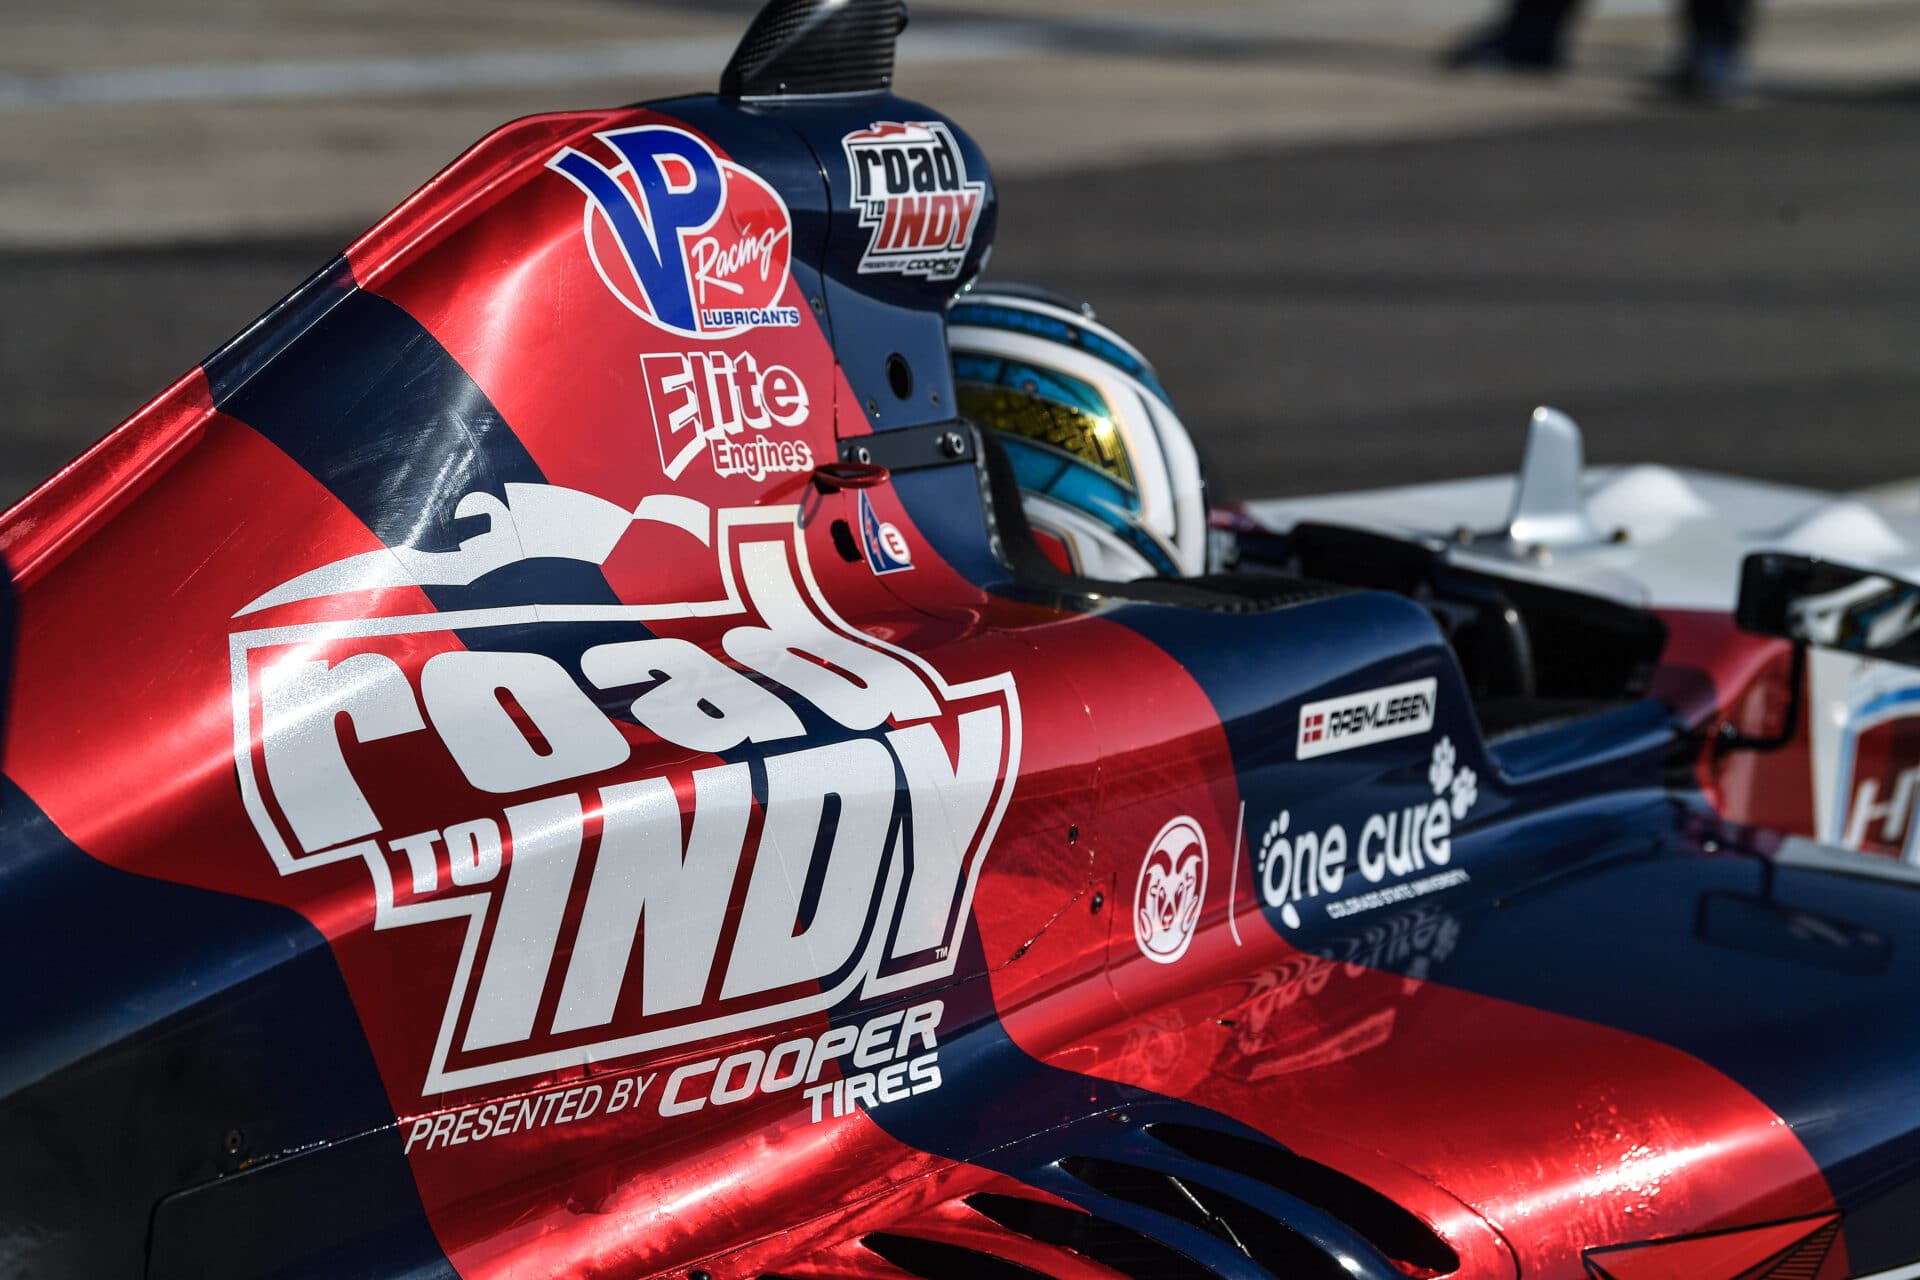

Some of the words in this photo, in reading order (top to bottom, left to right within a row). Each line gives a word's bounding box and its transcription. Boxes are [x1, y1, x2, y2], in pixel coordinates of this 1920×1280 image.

[855, 130, 961, 197] road
[546, 125, 727, 334] VP
[875, 194, 977, 250] INDY
[691, 225, 790, 304] Racing
[703, 308, 800, 327] LUBRICANTS
[639, 350, 810, 481] Elite
[711, 436, 814, 482] Engines
[884, 532, 905, 555] E
[260, 540, 941, 854] road
[390, 816, 504, 894] TO
[460, 704, 1003, 1053] INDY
[1261, 823, 1348, 909] one
[1357, 797, 1451, 883] cure
[404, 1086, 604, 1156] PRESENTED
[606, 1072, 658, 1114] BY
[658, 1000, 945, 1118] COOPER
[802, 1052, 944, 1124] TIRES
